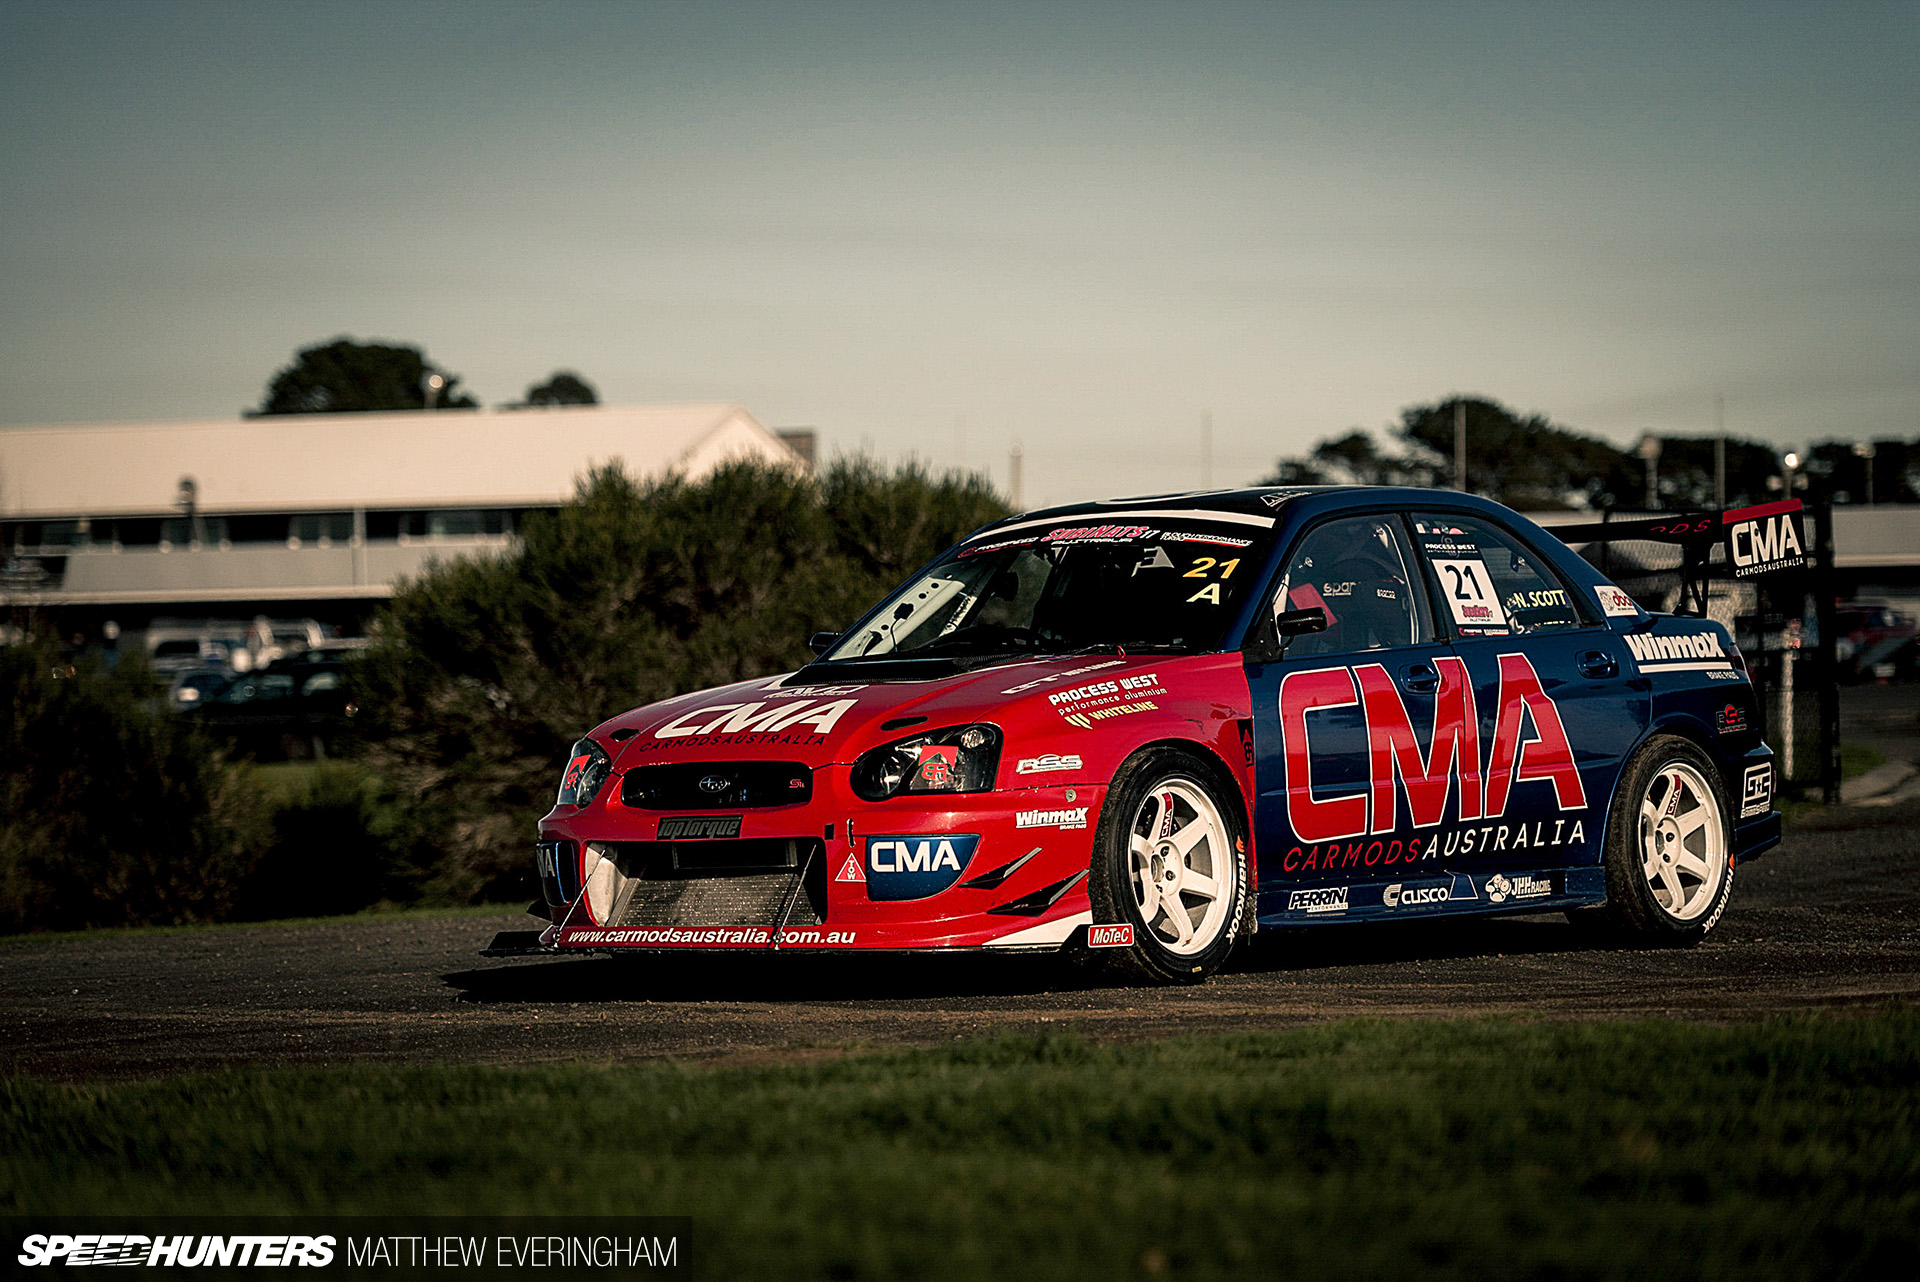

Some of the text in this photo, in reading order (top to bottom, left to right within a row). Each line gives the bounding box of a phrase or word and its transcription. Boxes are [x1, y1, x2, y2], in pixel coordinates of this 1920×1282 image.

[1731, 514, 1802, 567] CMA
[1182, 557, 1241, 579] 21
[1186, 583, 1220, 605] A
[1444, 564, 1484, 600] 21
[1528, 590, 1566, 607] SCOTT
[1047, 681, 1119, 706] PROCESS
[1119, 673, 1159, 691] WEST
[1057, 687, 1168, 716] performance aluminium
[655, 699, 859, 739] CMA
[1087, 700, 1159, 721] WHITELINE
[1279, 652, 1588, 843] CMA
[1161, 808, 1172, 837] CMA
[870, 841, 962, 873] CMA
[1288, 887, 1349, 910] PERRIN
[1401, 887, 1448, 905] CUSCO
[567, 927, 856, 945] www.carmodsaustralia.com.au
[1092, 925, 1130, 944] MoTeC
